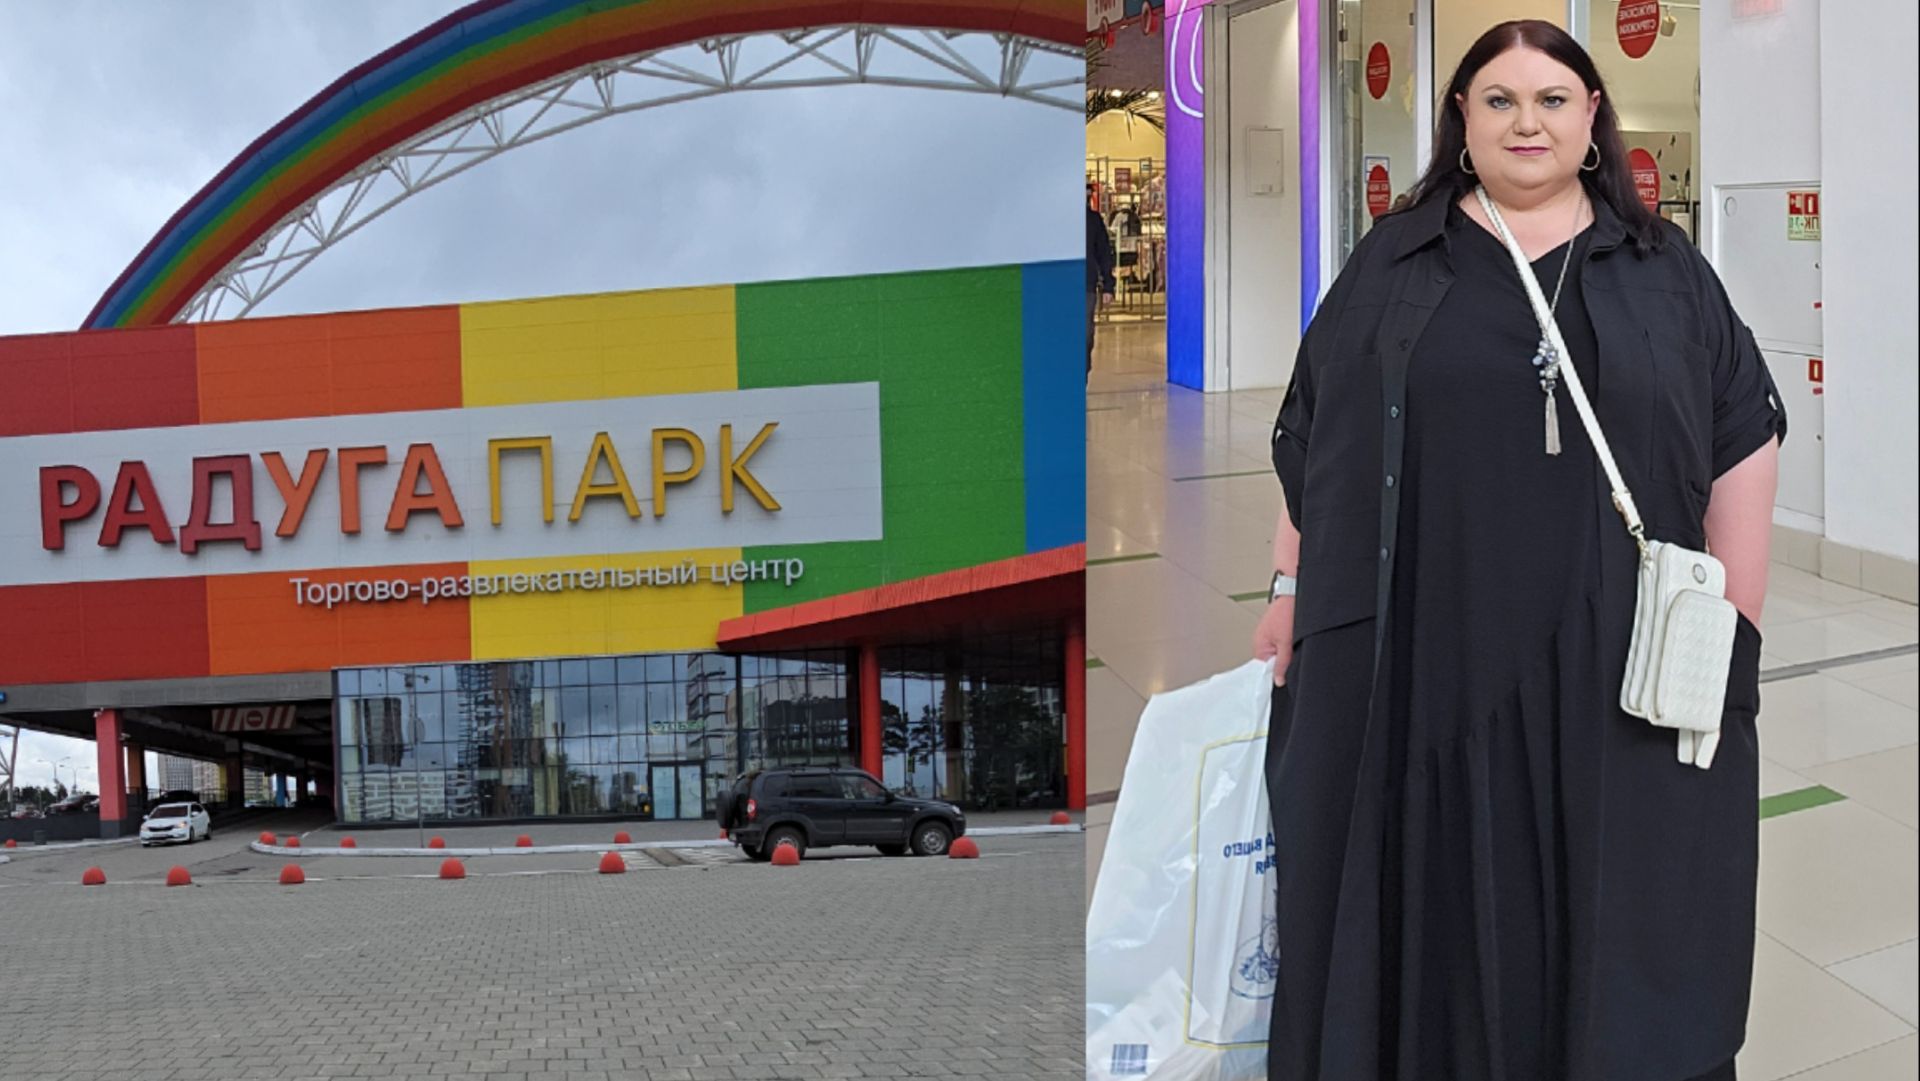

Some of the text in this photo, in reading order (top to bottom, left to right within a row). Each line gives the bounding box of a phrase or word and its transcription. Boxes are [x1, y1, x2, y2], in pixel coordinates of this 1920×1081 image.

[39, 421, 782, 555] РАДУГА ПАРК
[289, 557, 804, 609] Торгово-развлекательный центр
